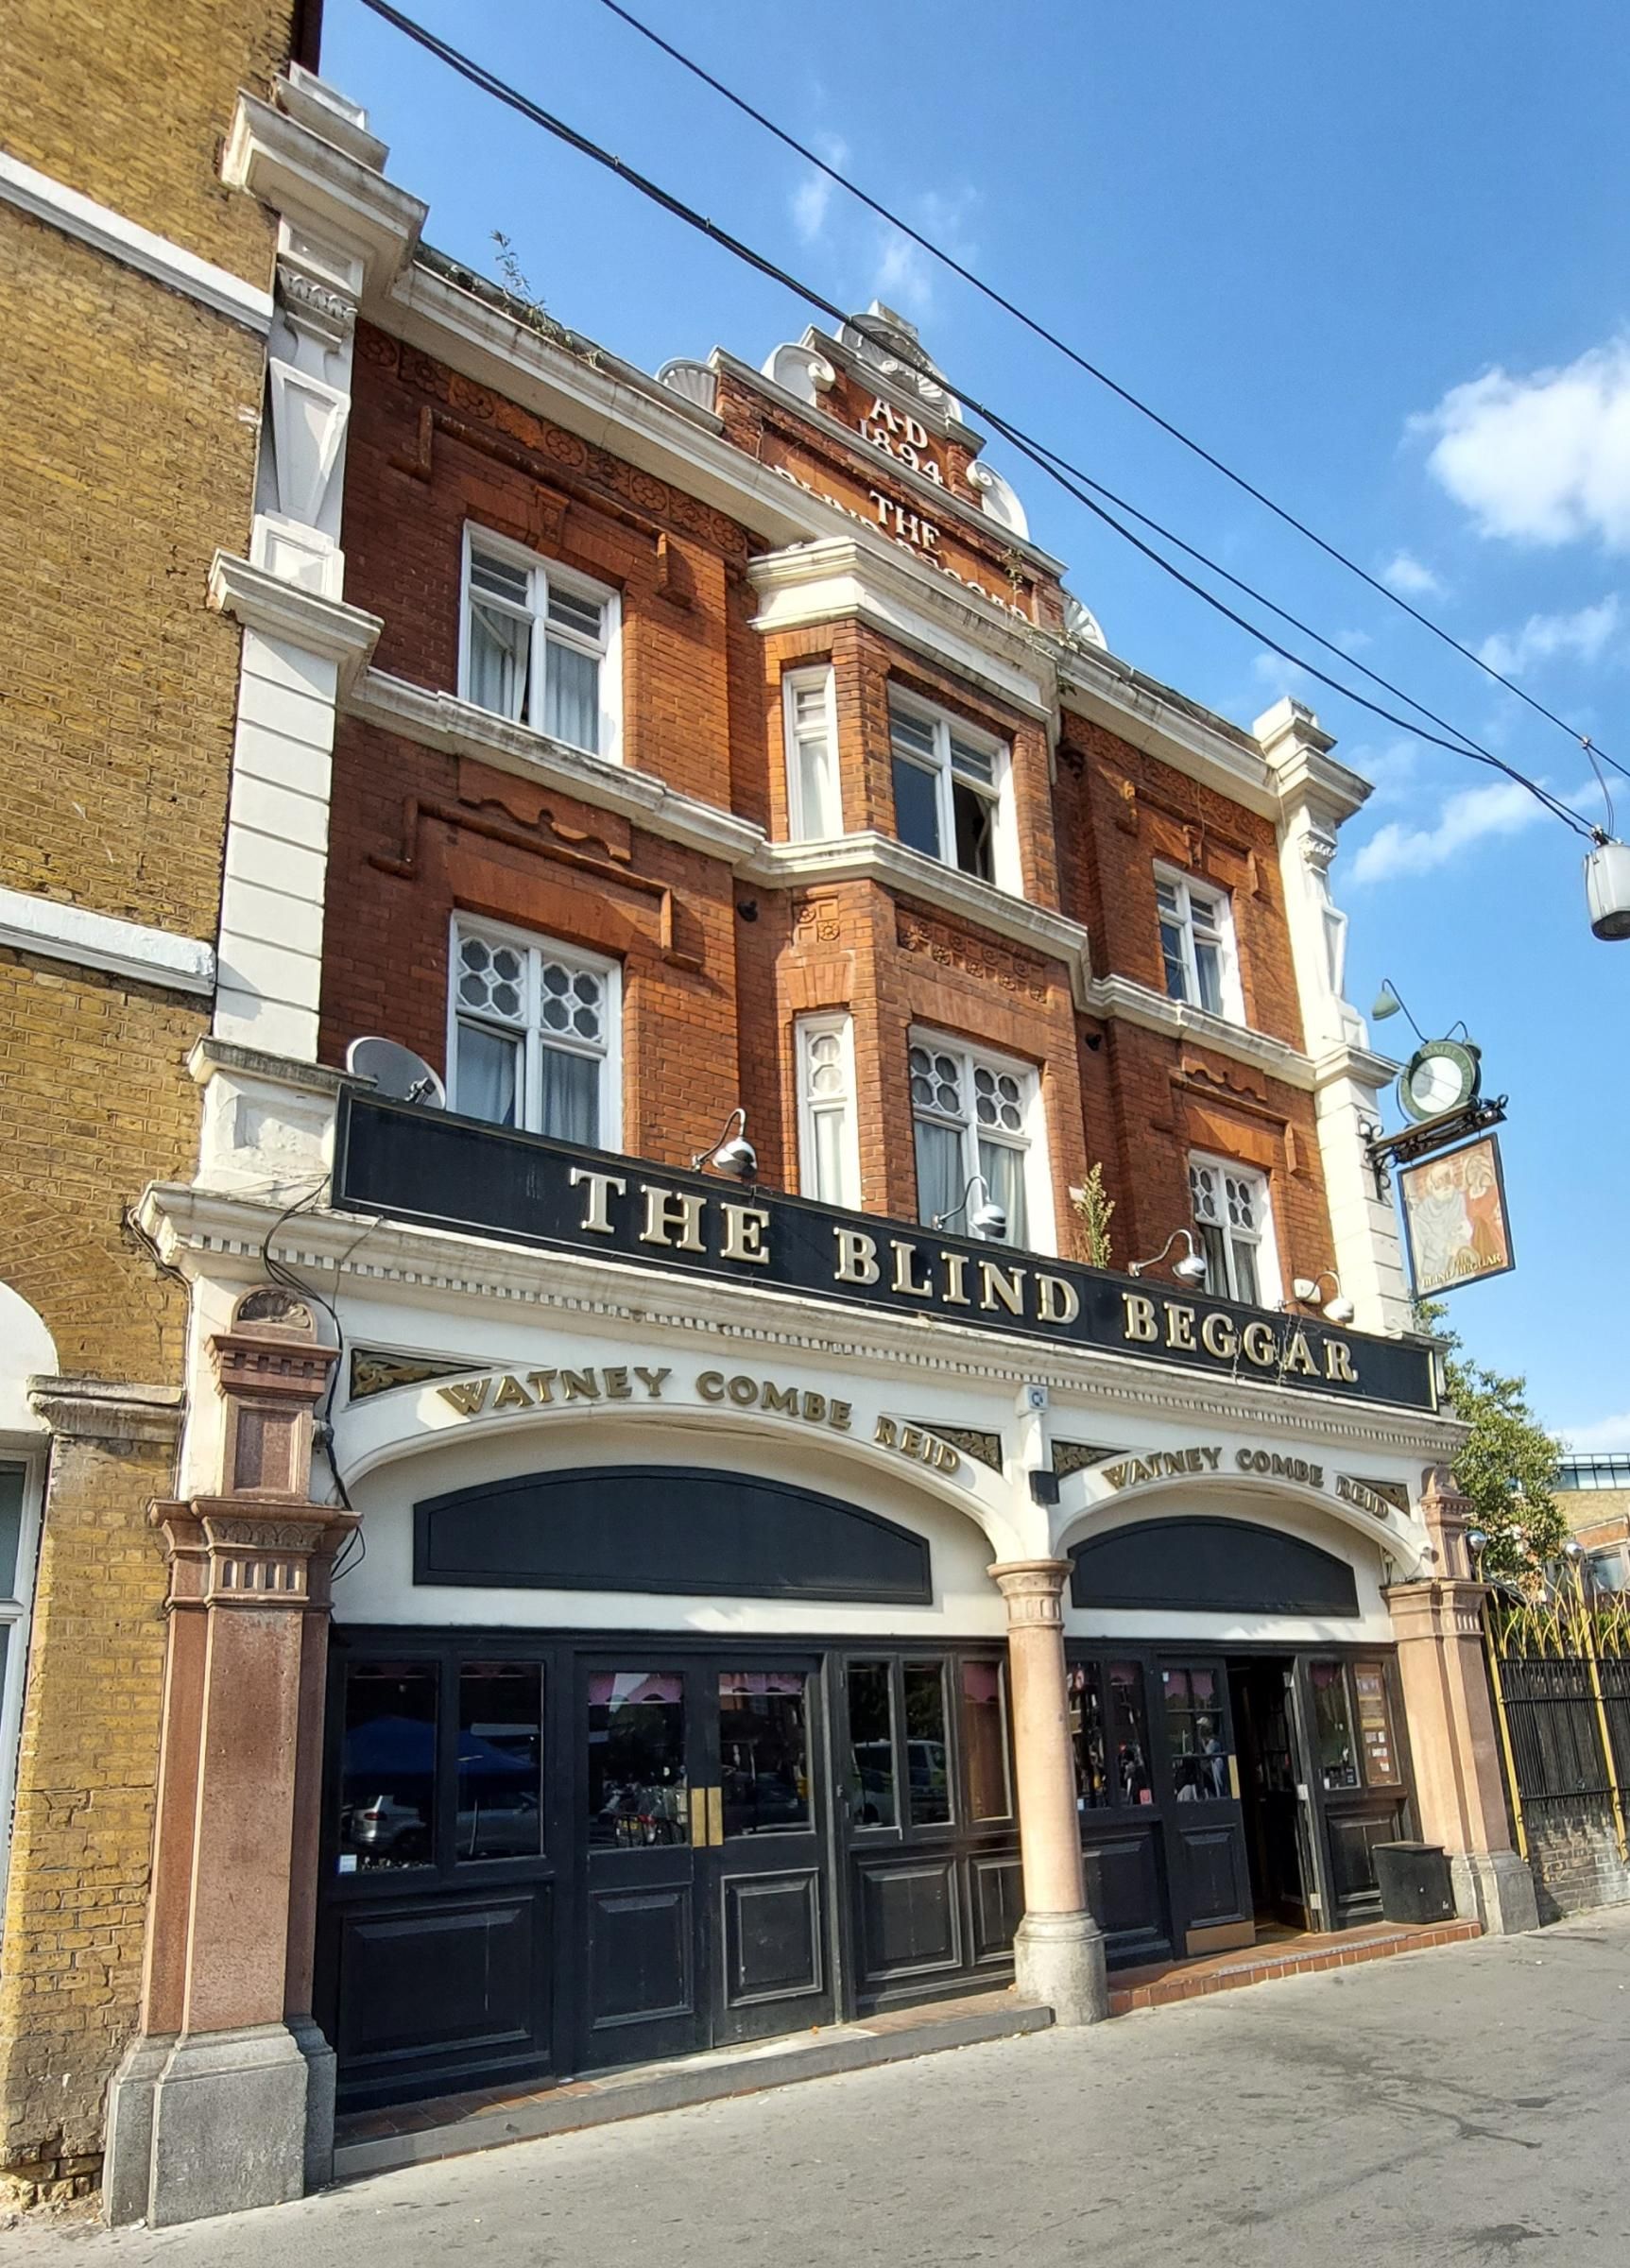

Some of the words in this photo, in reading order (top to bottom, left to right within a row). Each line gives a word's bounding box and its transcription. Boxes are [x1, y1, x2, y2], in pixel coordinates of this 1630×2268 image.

[859, 418, 943, 486] 1894
[869, 490, 942, 556] THE
[570, 1167, 770, 1264] THE
[833, 1227, 1081, 1325] BLIND
[1122, 1292, 1359, 1383] BEGGAR
[436, 1366, 672, 1415] WATNEY
[695, 1371, 852, 1430] COMBE
[874, 1416, 960, 1472] REID
[1102, 1447, 1223, 1490] WATNEY
[1235, 1448, 1324, 1487] COMBE
[1336, 1475, 1389, 1519] REID
